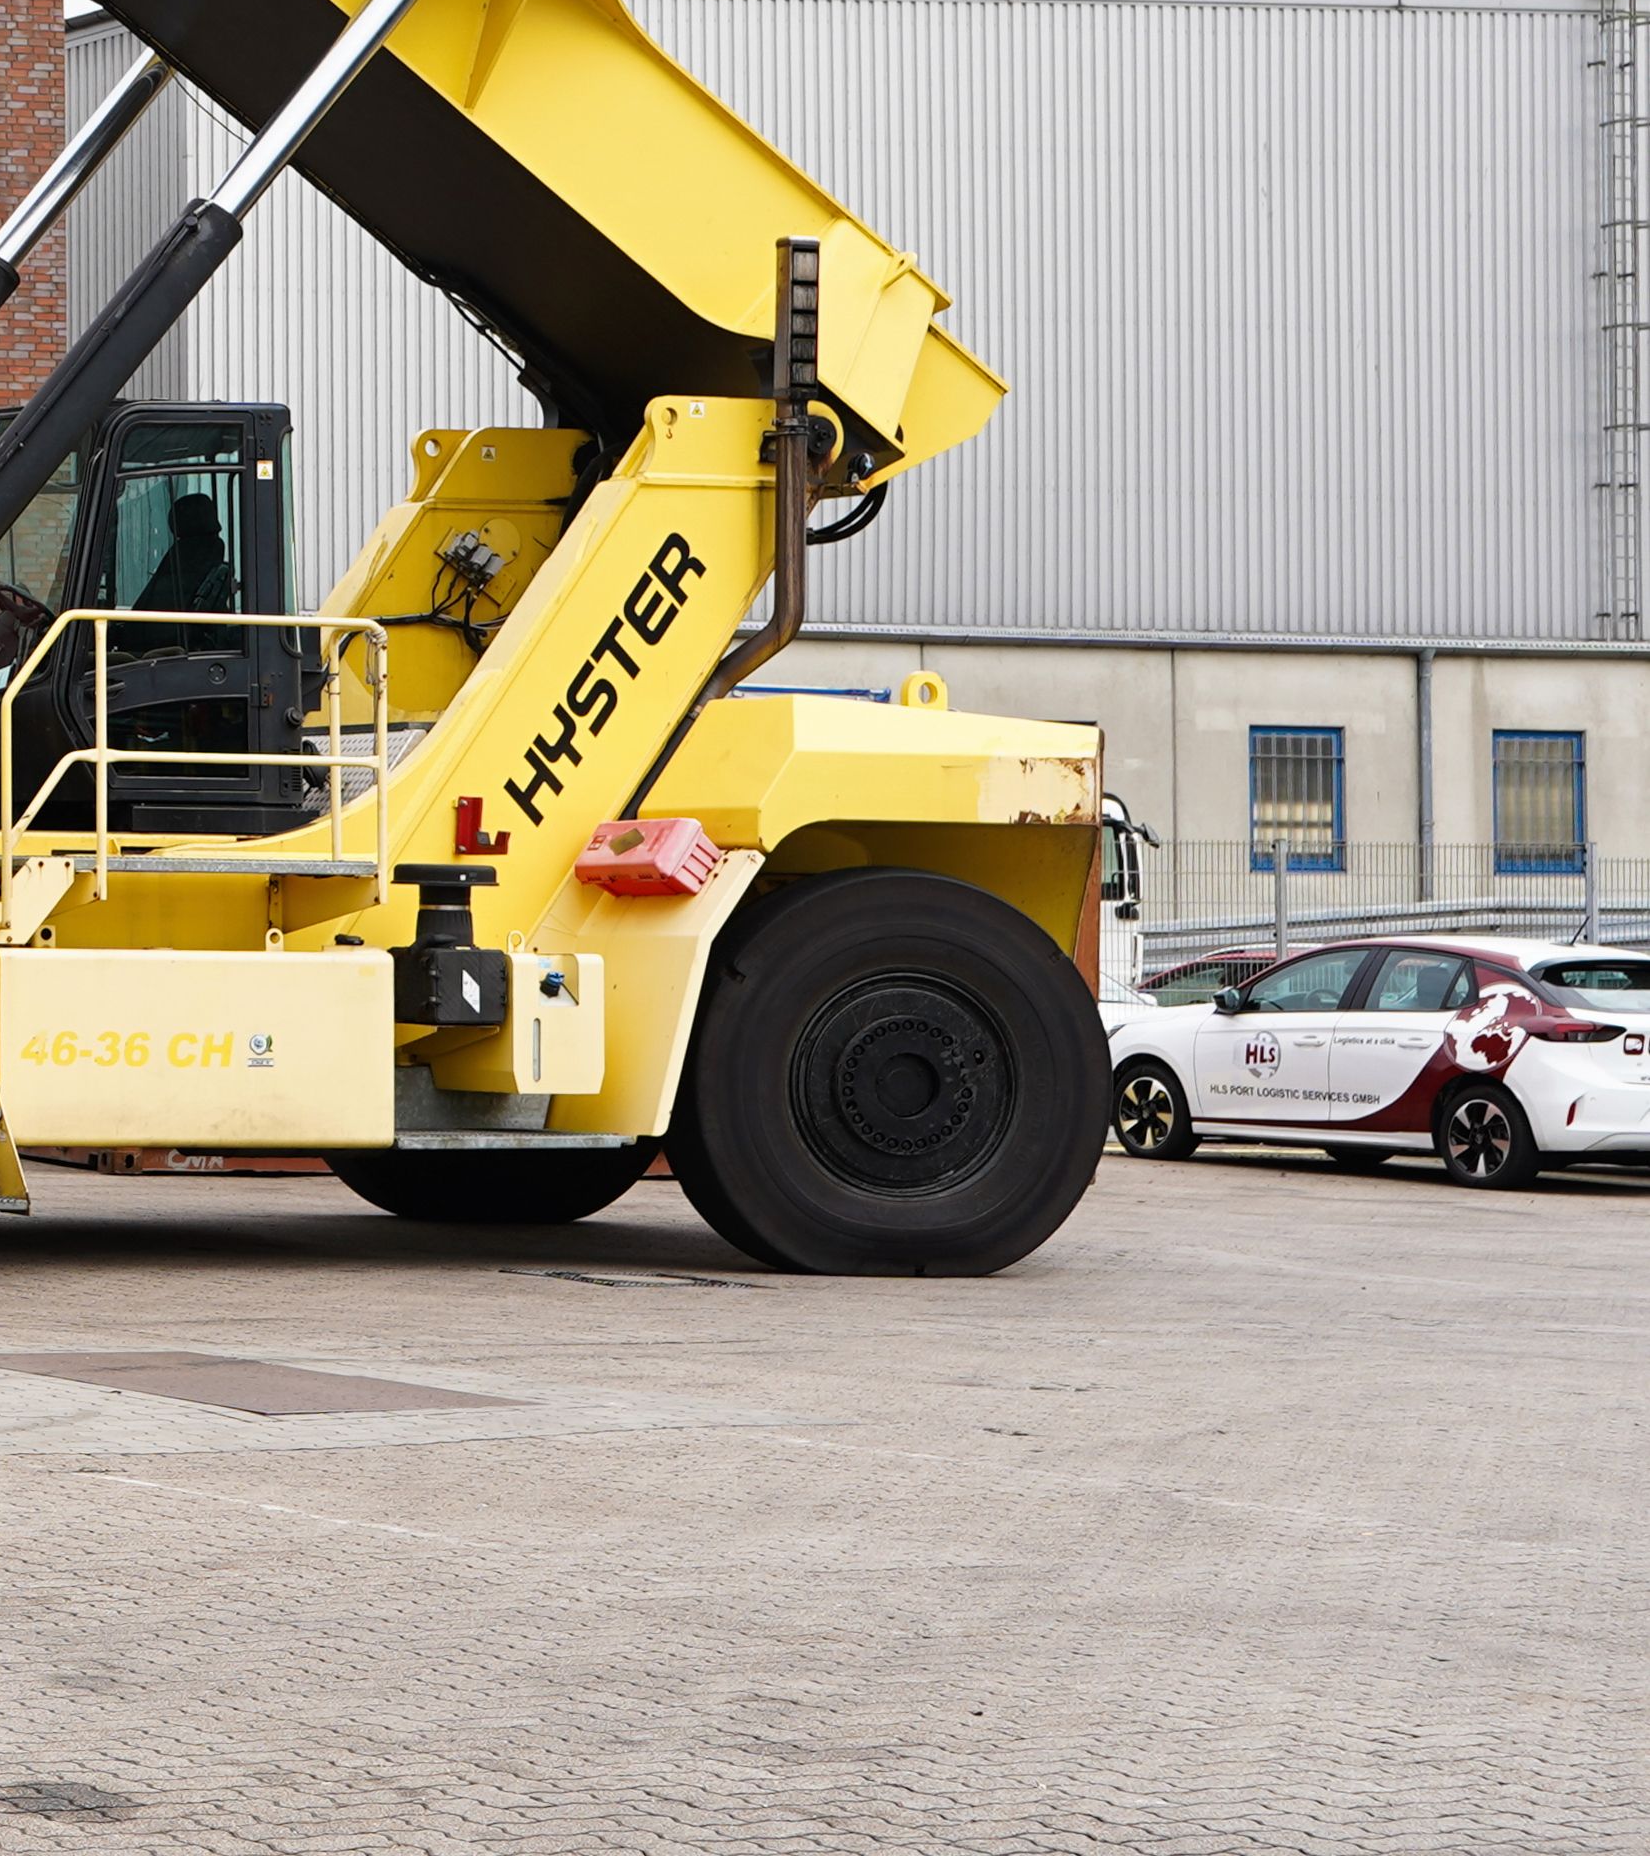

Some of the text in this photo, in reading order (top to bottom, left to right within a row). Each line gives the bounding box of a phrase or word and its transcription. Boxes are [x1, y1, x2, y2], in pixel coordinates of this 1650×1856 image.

[503, 532, 707, 827] HYSTER
[20, 1030, 234, 1069] 46-36 CH
[1245, 1043, 1276, 1065] HLS
[1210, 1084, 1381, 1104] HLS PORT LOGISTIC SERVICES GMBH
